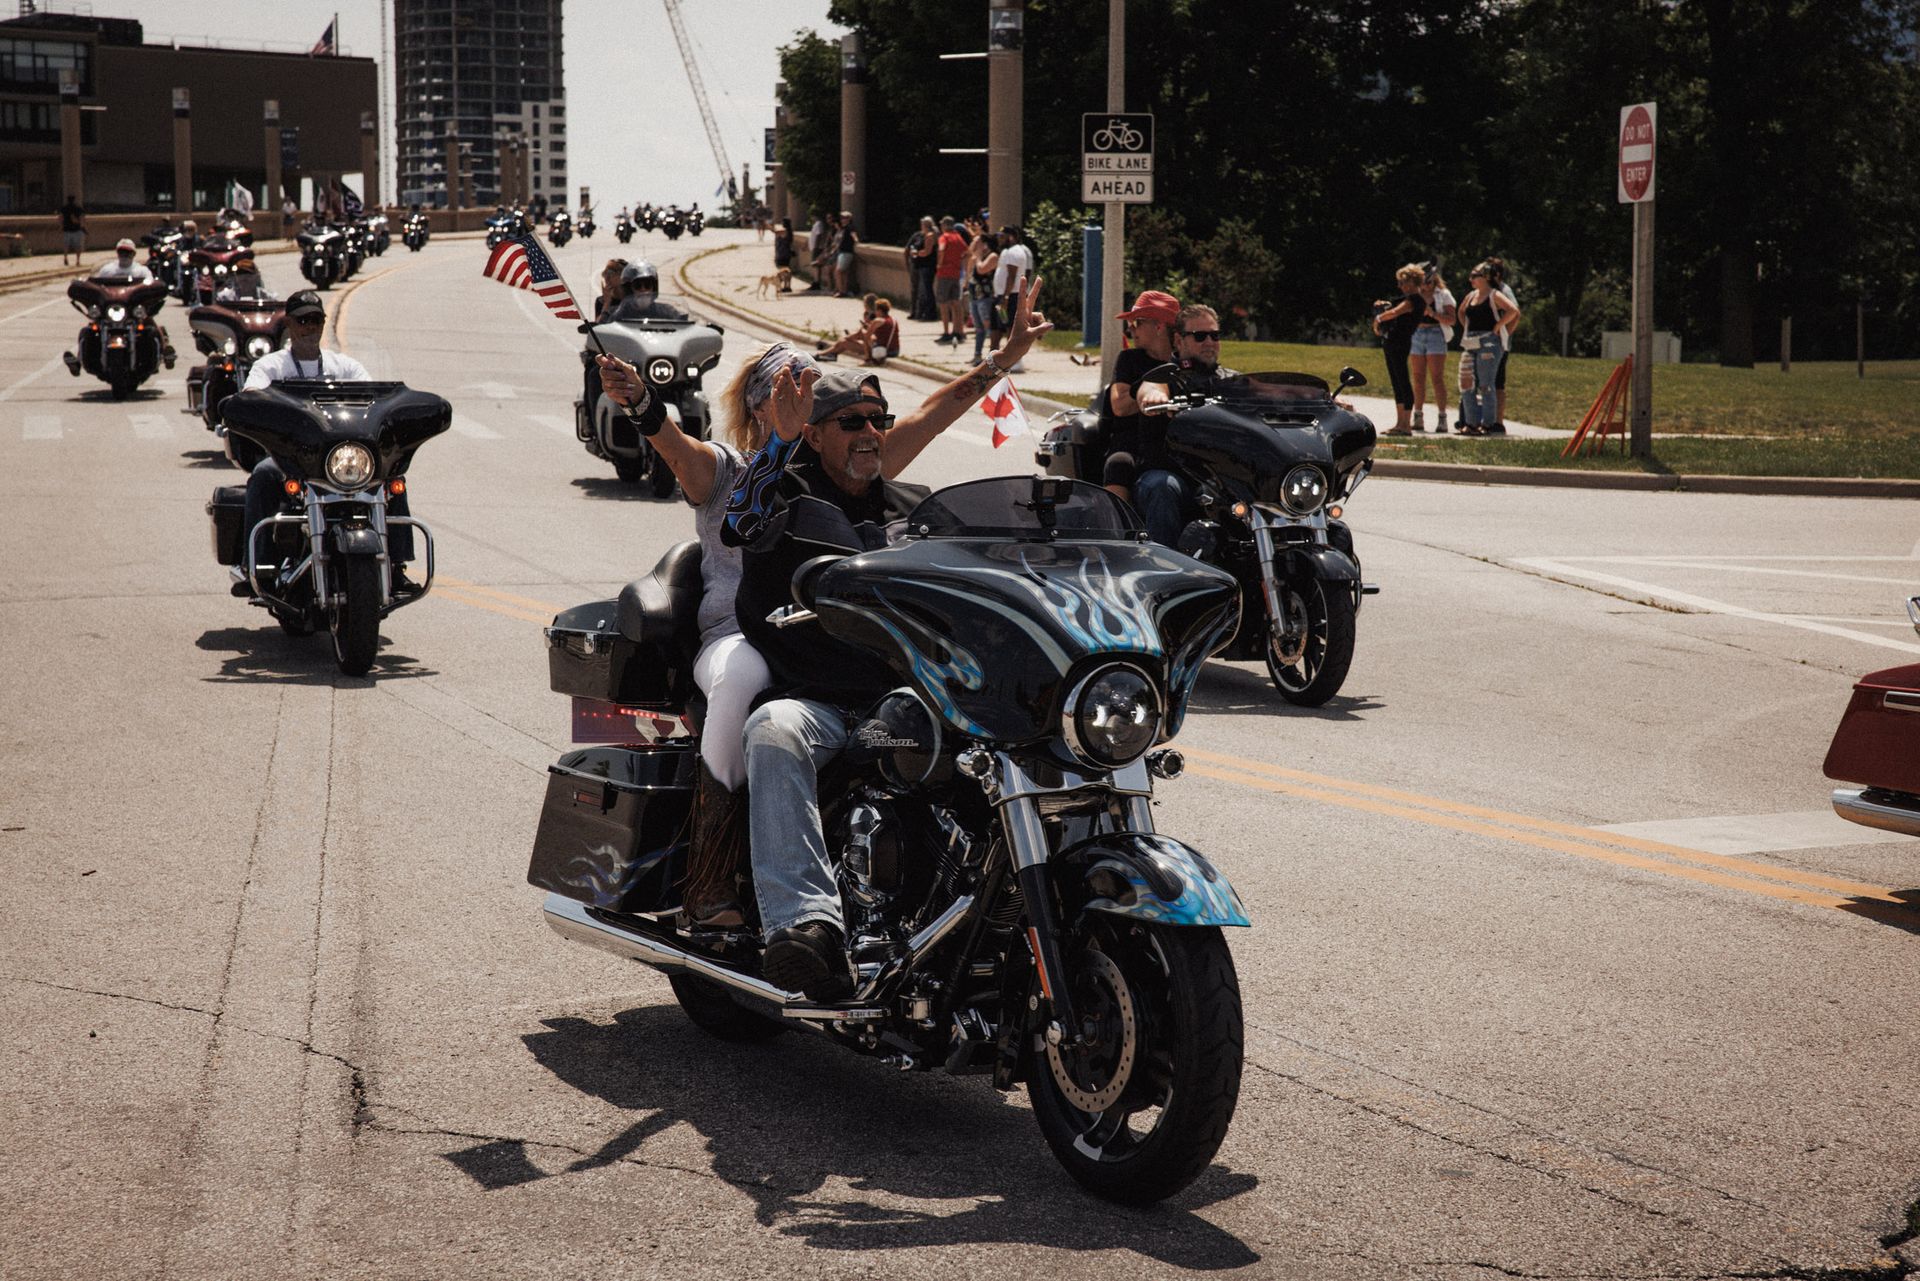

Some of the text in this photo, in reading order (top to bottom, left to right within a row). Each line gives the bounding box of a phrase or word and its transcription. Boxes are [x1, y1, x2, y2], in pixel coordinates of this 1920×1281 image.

[1625, 123, 1650, 141] DO NOT
[1088, 158, 1148, 169] BIKE LANE
[1626, 166, 1647, 182] ENTER
[1091, 181, 1145, 195] AHEAD
